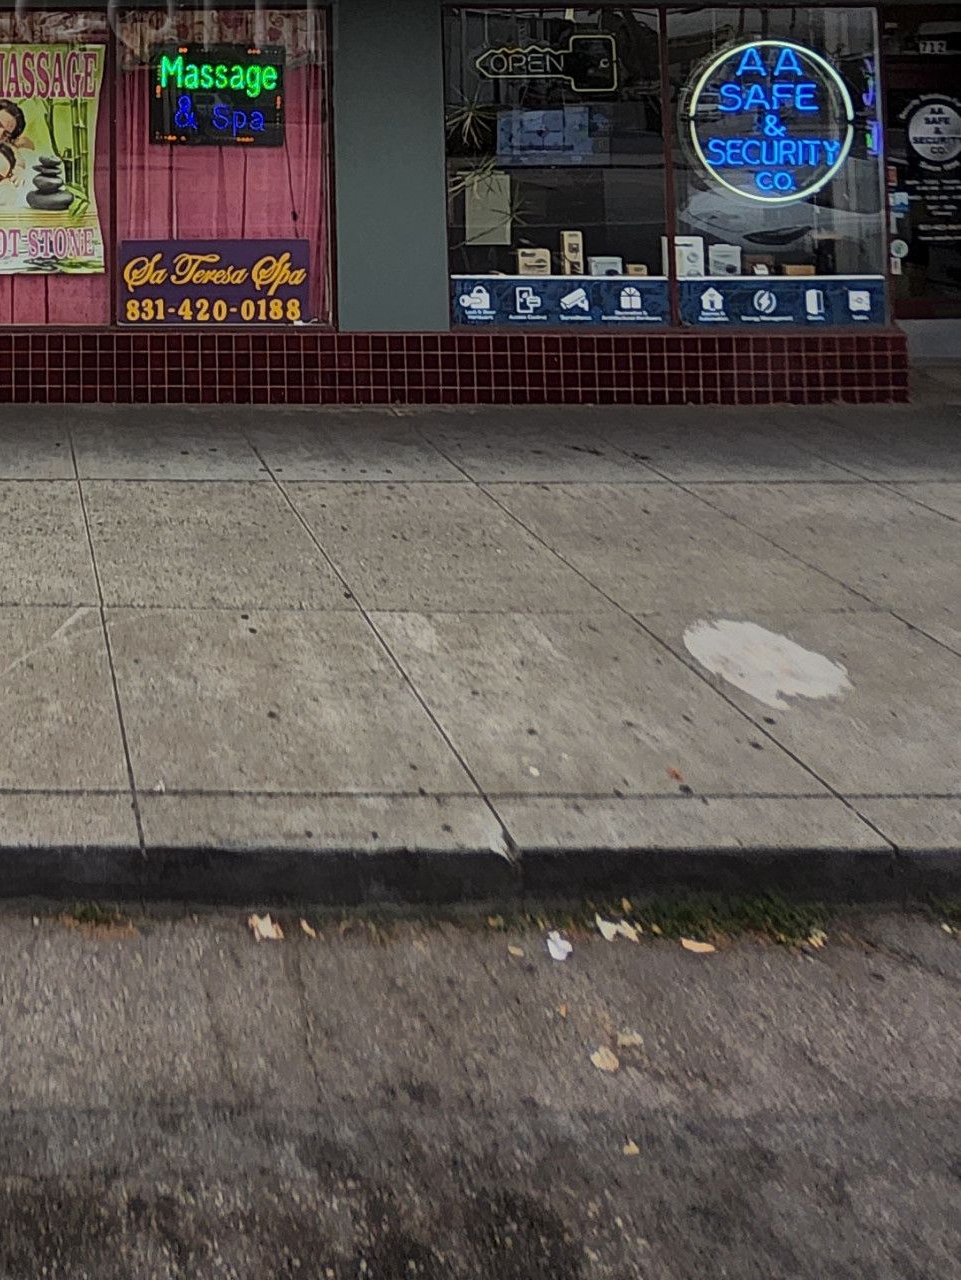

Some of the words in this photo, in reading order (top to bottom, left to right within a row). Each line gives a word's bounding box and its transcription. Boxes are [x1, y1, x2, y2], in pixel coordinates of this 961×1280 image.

[161, 55, 278, 98] Massage
[490, 54, 564, 73] OPEN
[718, 83, 819, 111] SAFE
[175, 95, 198, 129] &
[212, 103, 265, 137] Spa
[763, 114, 787, 137] &
[705, 139, 841, 166] SECURITY
[28, 228, 95, 258] STONE
[123, 253, 169, 292] Sa
[170, 253, 248, 286] Teresa
[251, 252, 307, 296] Spa
[126, 298, 301, 321] 831-420-0188
